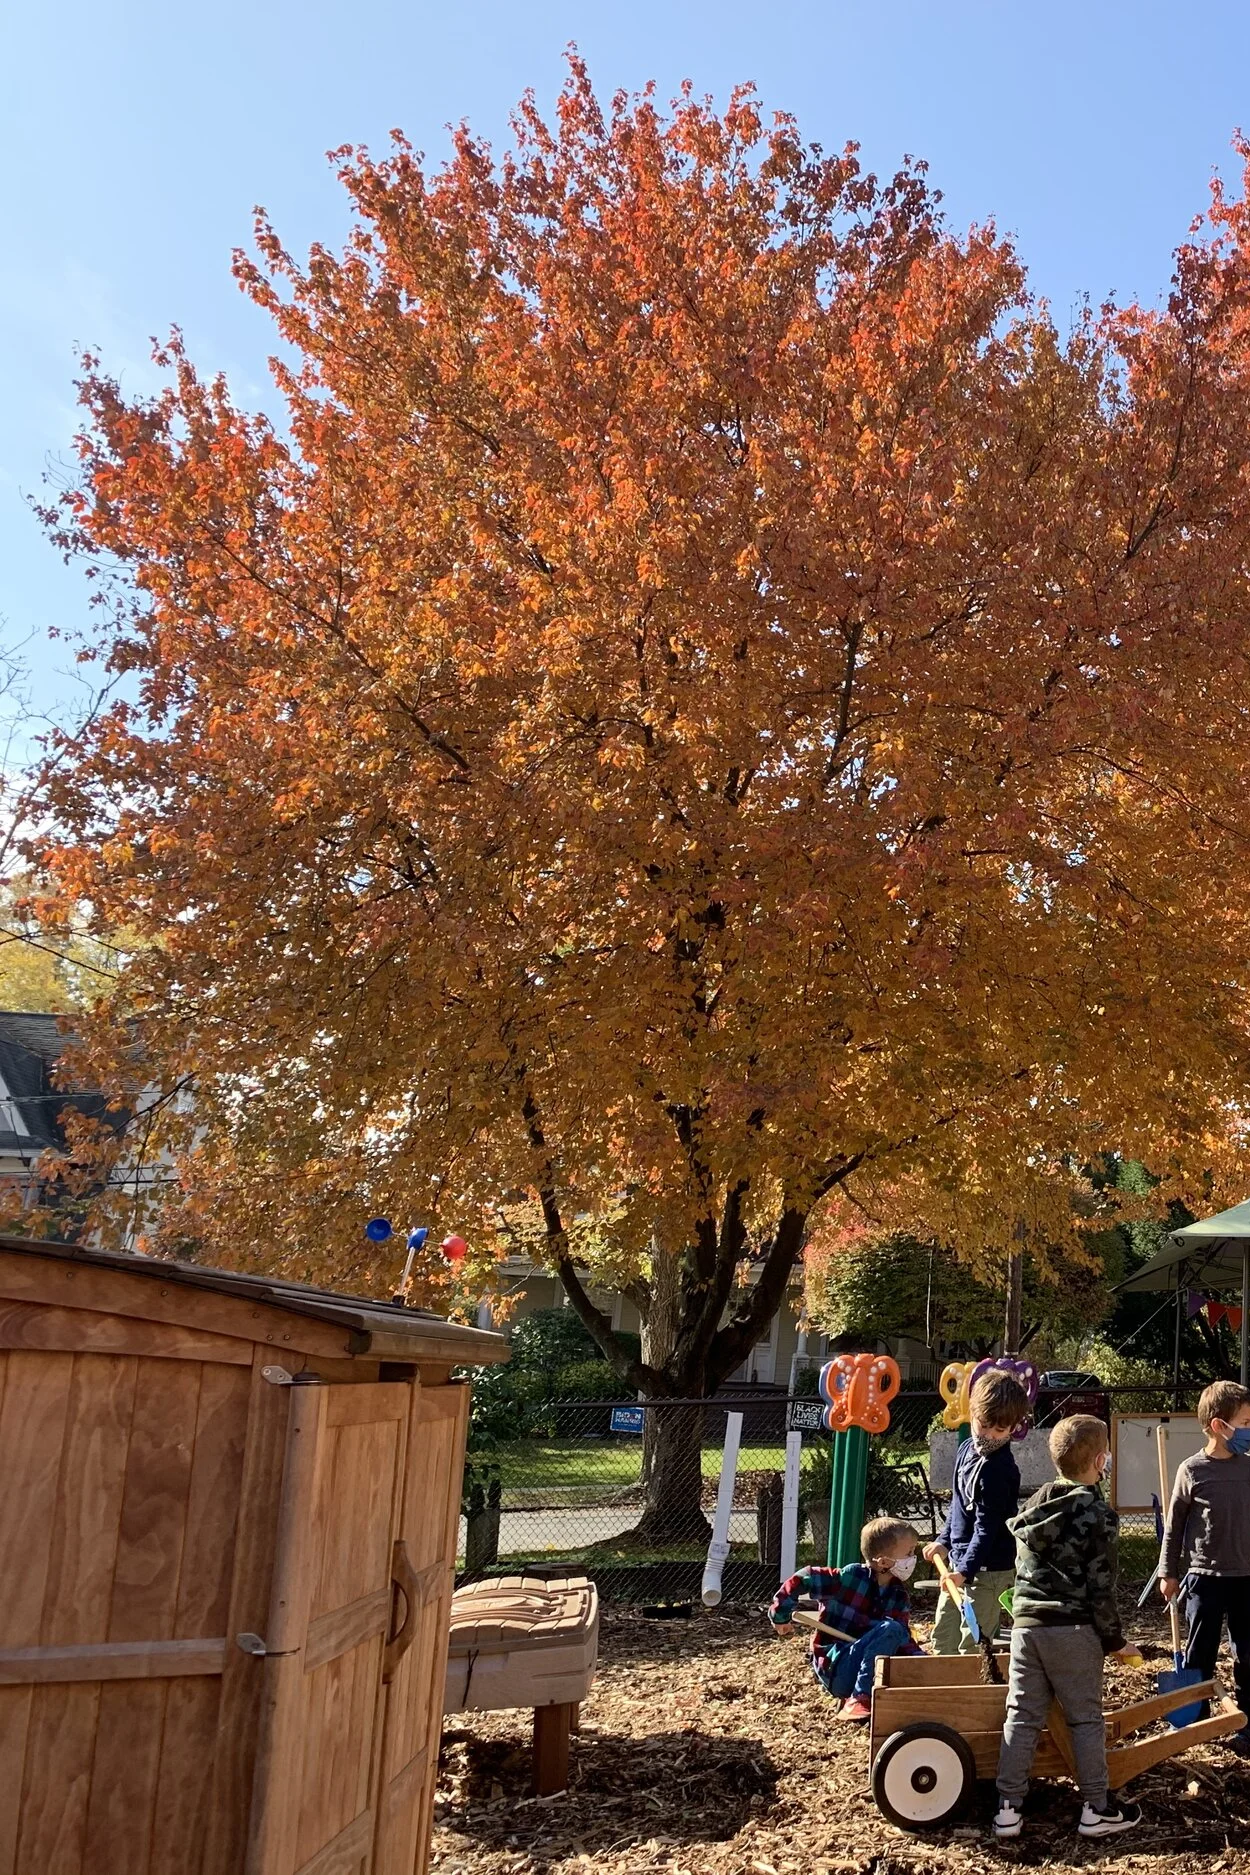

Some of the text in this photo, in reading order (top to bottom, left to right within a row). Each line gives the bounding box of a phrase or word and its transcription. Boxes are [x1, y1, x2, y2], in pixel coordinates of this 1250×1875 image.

[797, 1404, 821, 1413] BLACK
[796, 1412, 818, 1420] LIVES
[794, 1418, 818, 1426] MATTER
